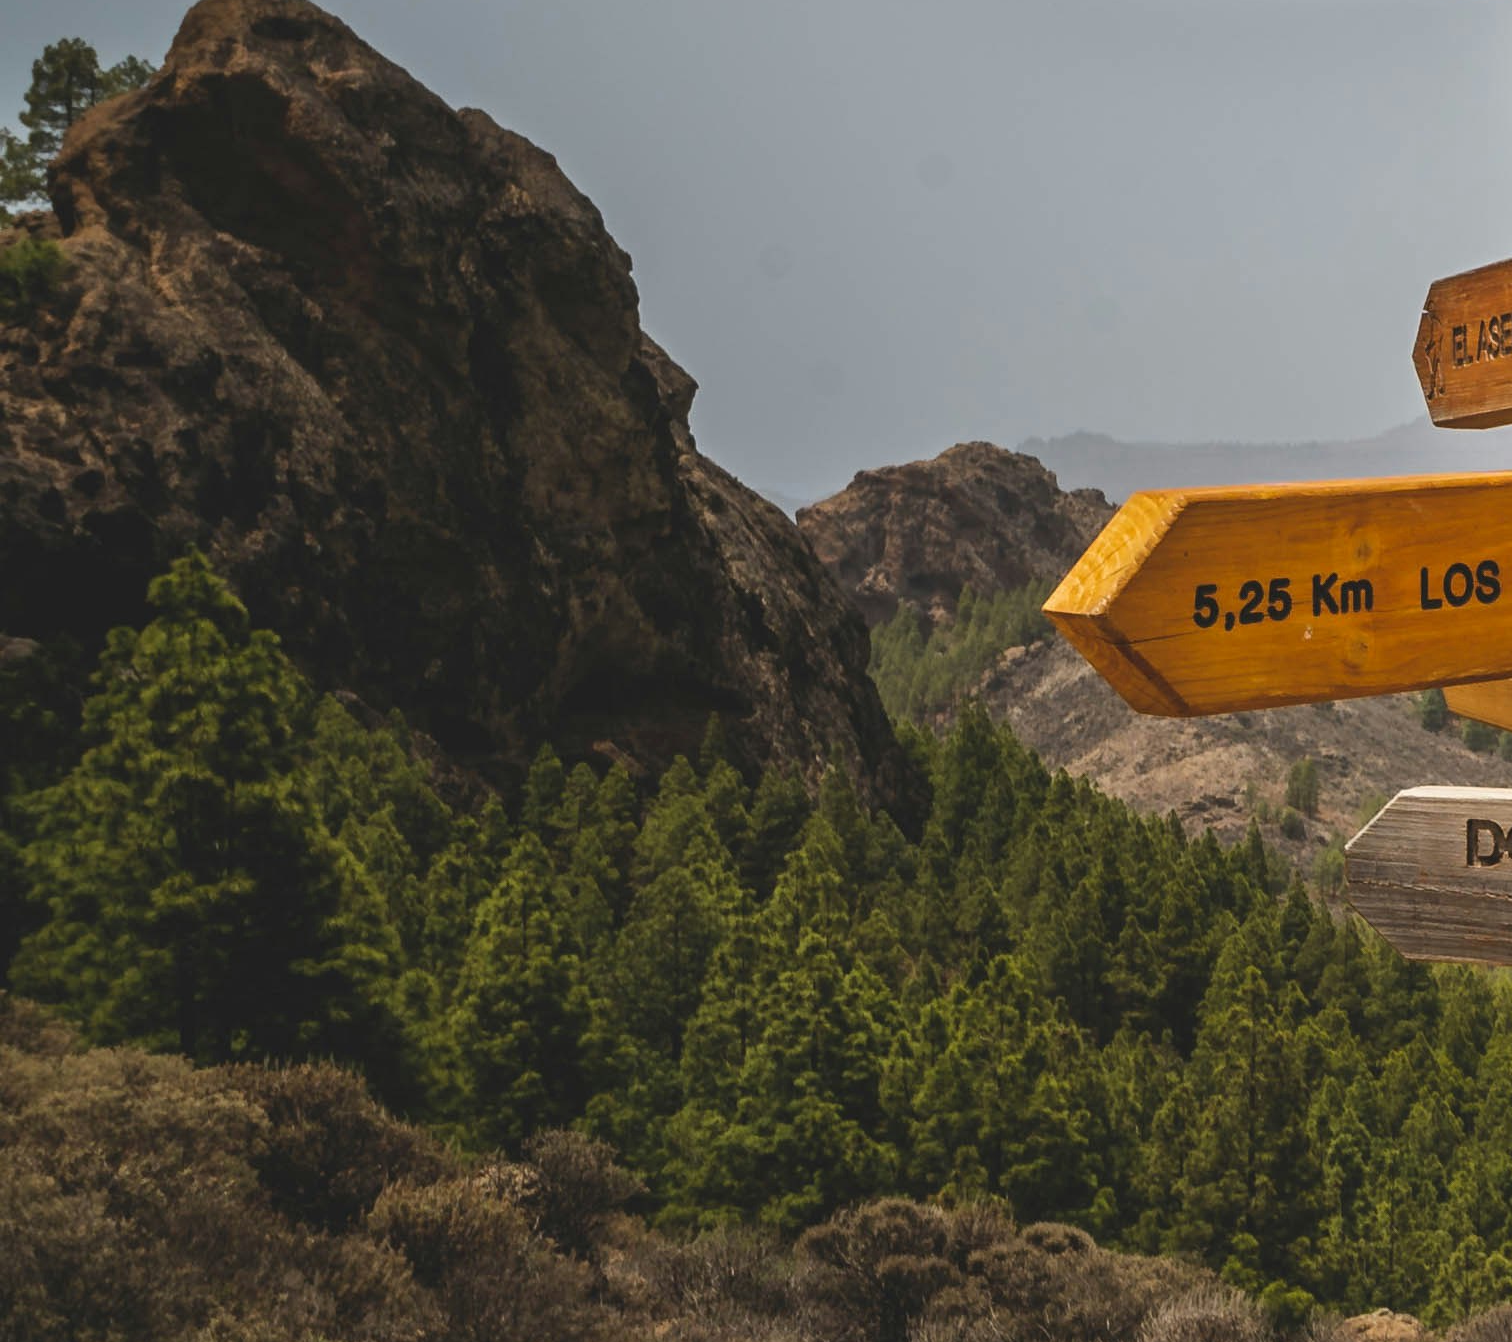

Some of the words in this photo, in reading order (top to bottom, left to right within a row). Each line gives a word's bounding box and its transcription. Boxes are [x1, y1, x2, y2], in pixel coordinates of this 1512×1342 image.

[1452, 322, 1473, 368] EL
[1193, 578, 1293, 631] 5,25
[1312, 572, 1374, 616] Km
[1420, 560, 1501, 610] LOS
